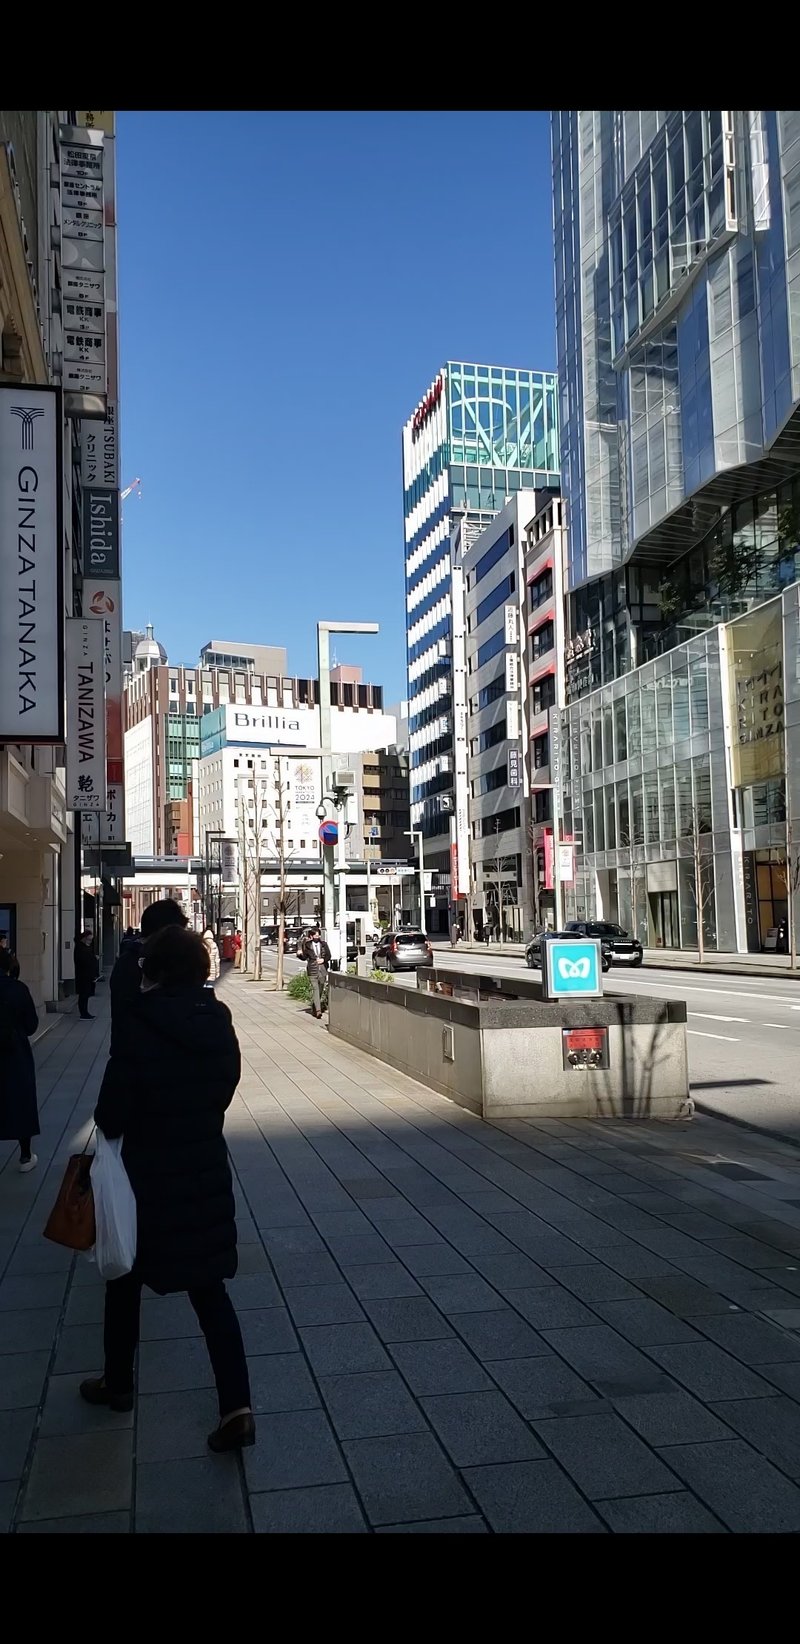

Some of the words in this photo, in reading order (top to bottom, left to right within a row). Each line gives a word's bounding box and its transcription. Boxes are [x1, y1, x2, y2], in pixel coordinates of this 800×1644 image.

[86, 434, 97, 482] クリニック
[104, 427, 115, 484] TSUBAKI
[18, 465, 38, 576] GINZA
[90, 493, 112, 565] Ishida
[18, 580, 37, 715] TANAKA
[78, 661, 95, 763] TANIZAWA
[234, 713, 299, 731] Brillia
[107, 789, 116, 832] ポーカー
[744, 856, 753, 925] KIRARITO
